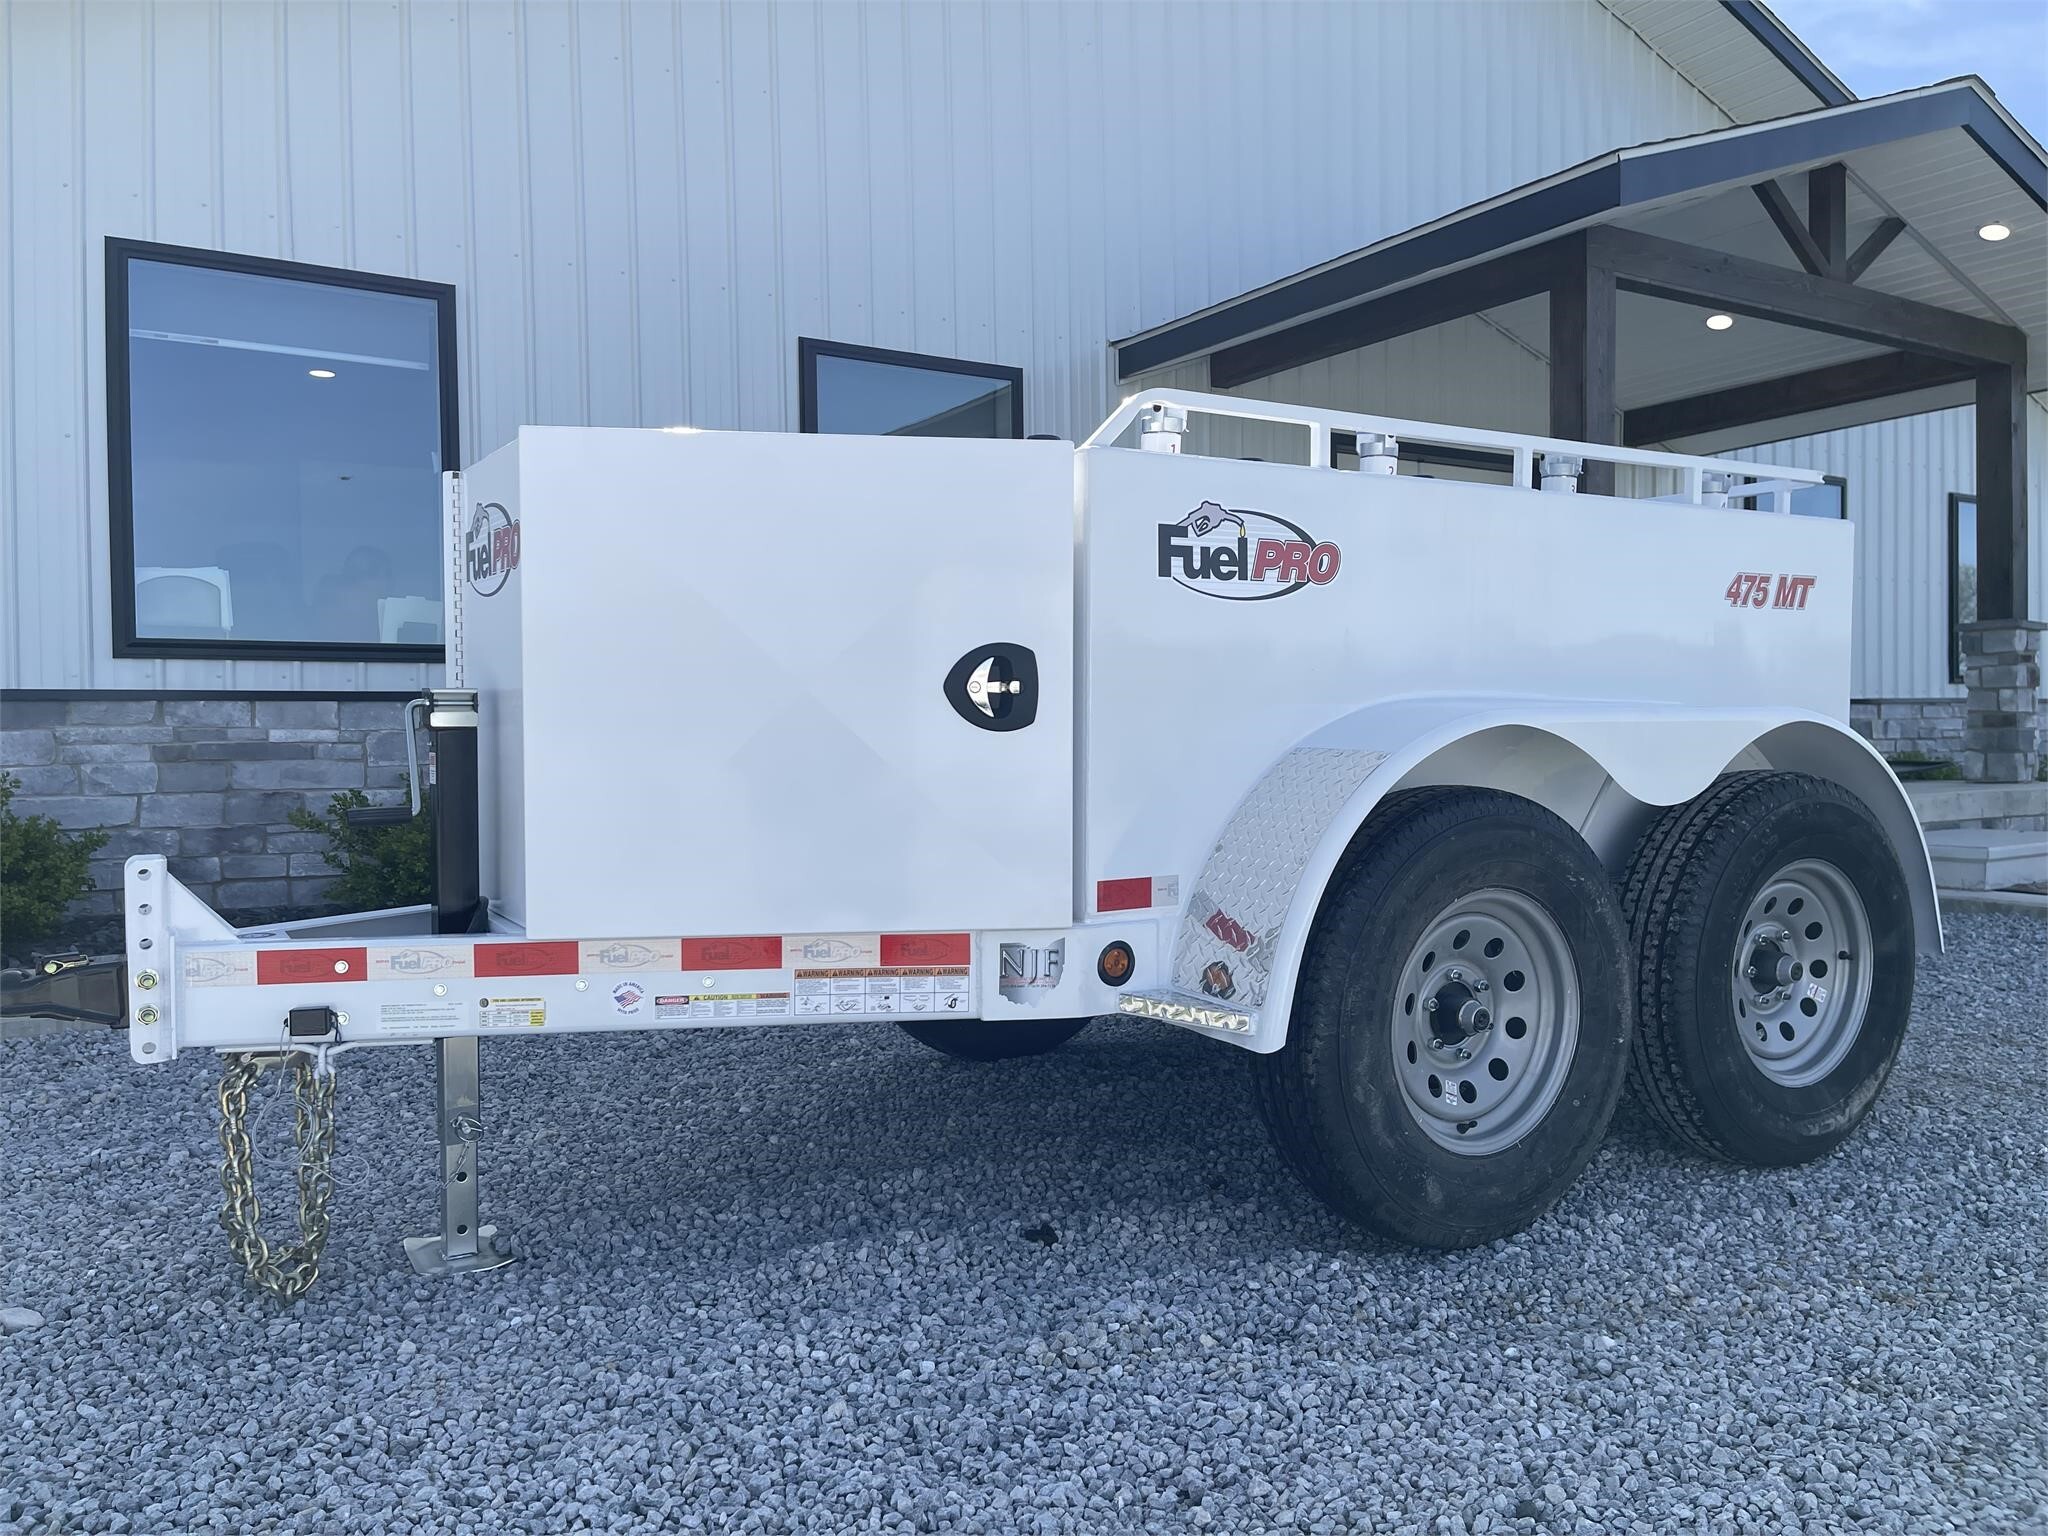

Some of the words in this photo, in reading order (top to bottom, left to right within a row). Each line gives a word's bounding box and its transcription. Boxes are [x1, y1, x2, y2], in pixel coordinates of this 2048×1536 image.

[1724, 571, 1773, 609] 475
[1771, 573, 1818, 610] MT
[1000, 948, 1059, 984] NJF
[802, 970, 829, 978] WARNING
[838, 969, 864, 977] WARNING
[873, 968, 900, 976] WARNING
[908, 967, 934, 975] WARNING
[942, 967, 968, 975] WARNING
